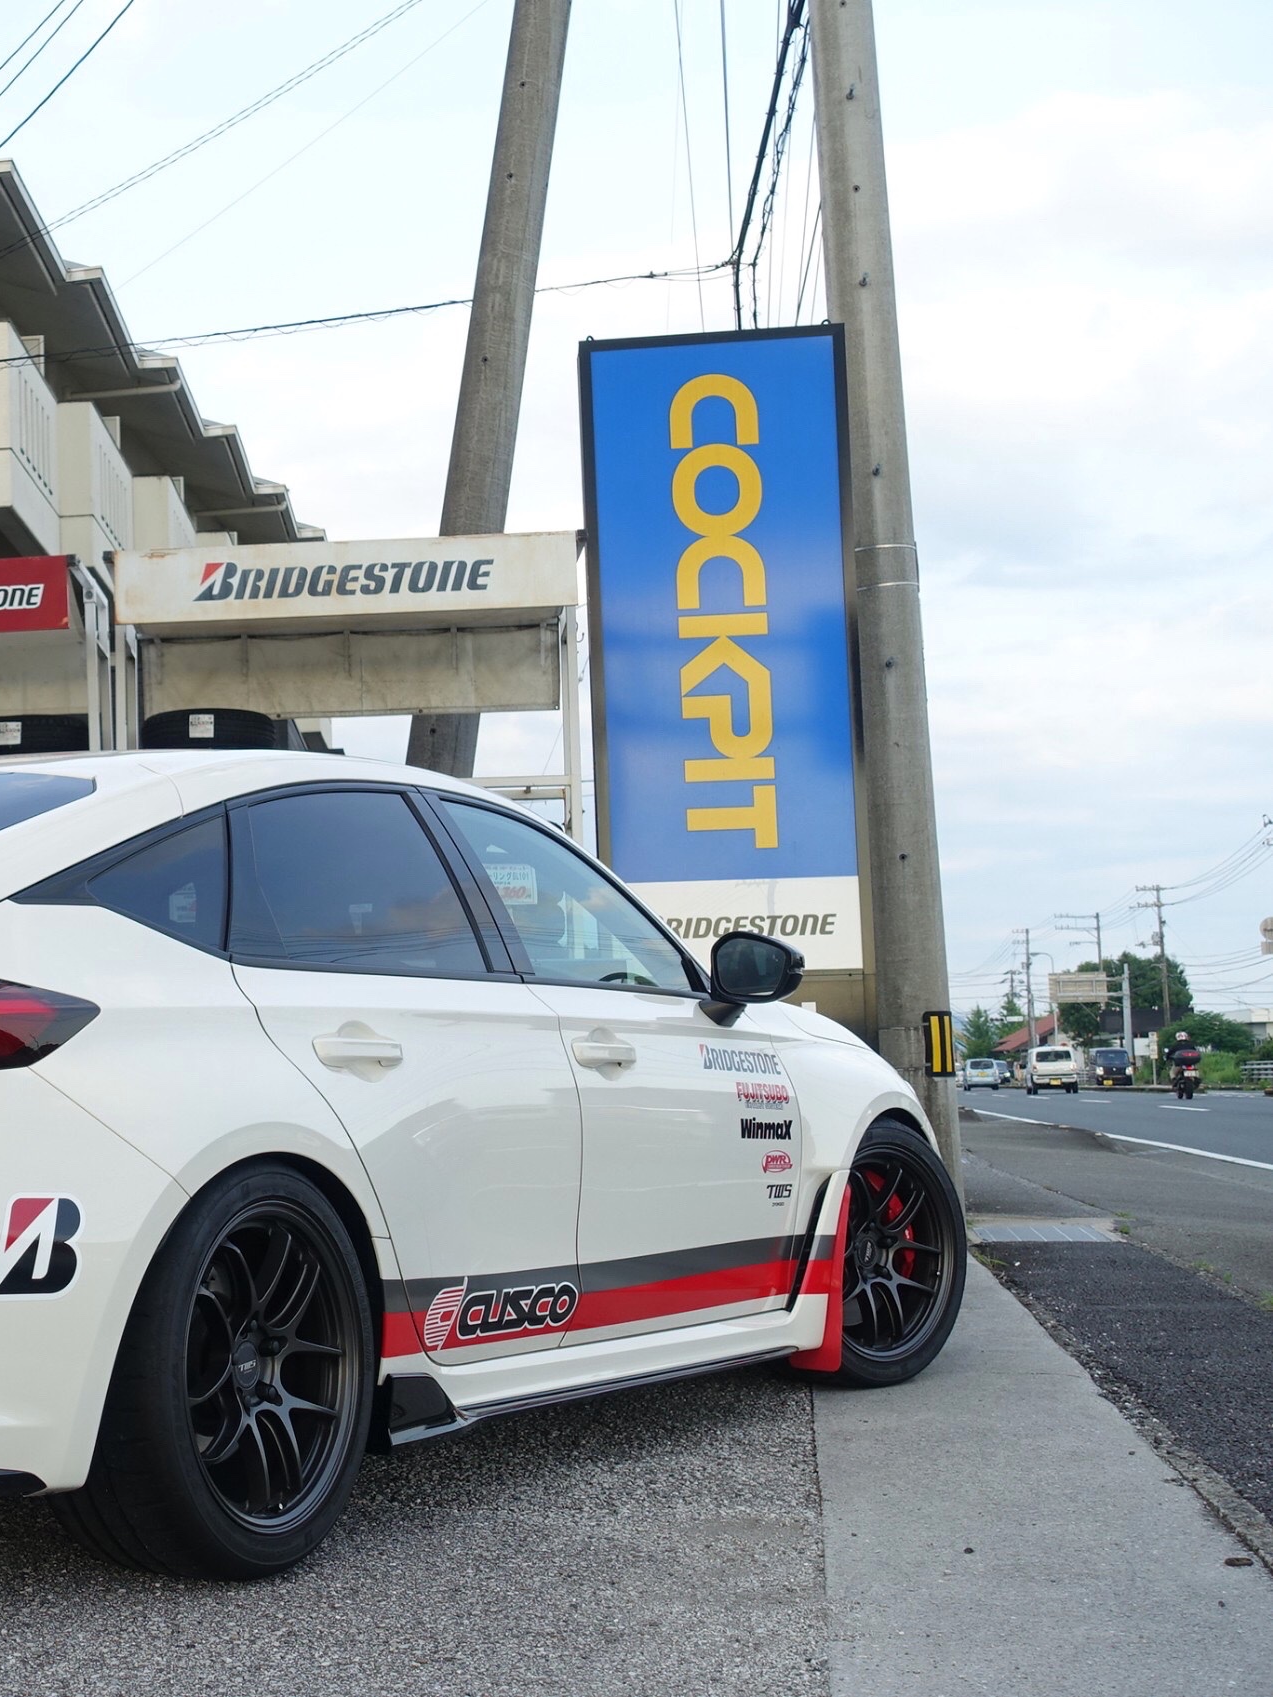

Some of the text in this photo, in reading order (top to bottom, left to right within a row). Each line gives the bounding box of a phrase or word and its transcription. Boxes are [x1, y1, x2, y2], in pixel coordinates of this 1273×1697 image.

[193, 559, 494, 601] BRIDGESTONE
[670, 373, 779, 849] COCKPIT
[659, 913, 837, 940] RIDGESTONE
[699, 1044, 781, 1075] BRIDGESTONE
[735, 1081, 790, 1104] FUJITSUBO
[766, 1184, 792, 1199] TWS
[458, 1283, 578, 1337] CUSCO
